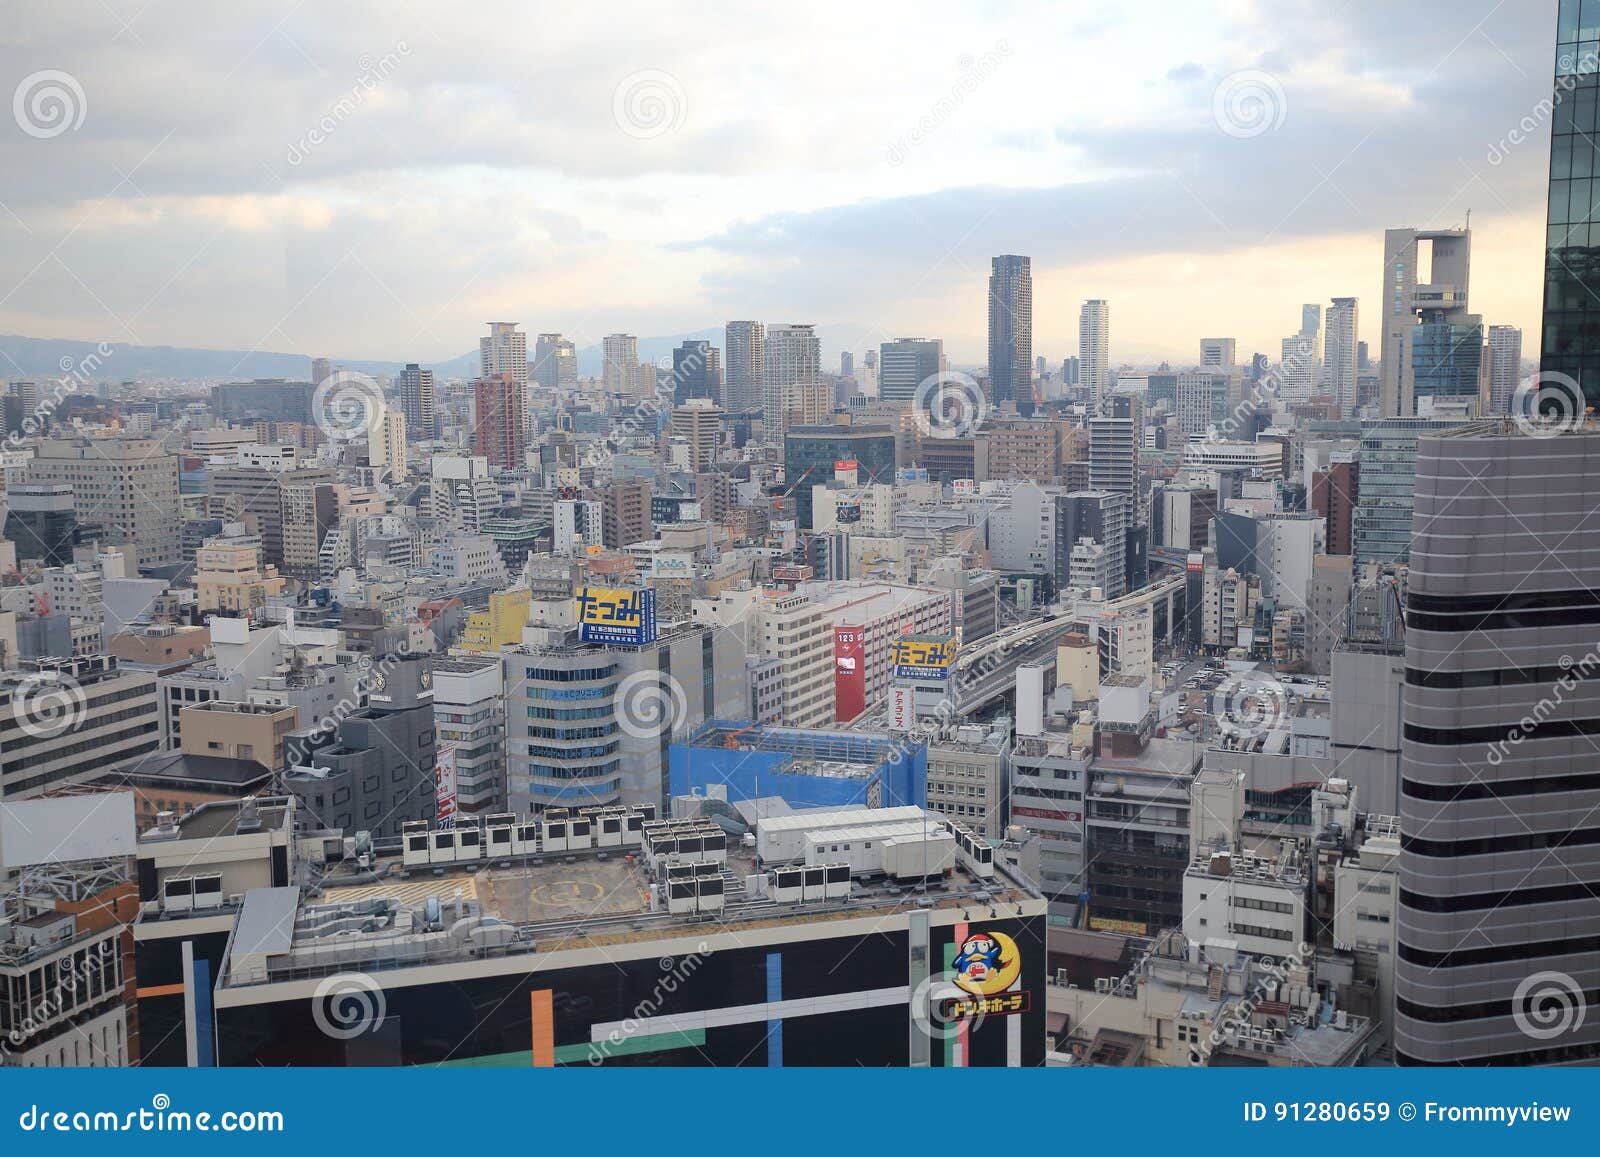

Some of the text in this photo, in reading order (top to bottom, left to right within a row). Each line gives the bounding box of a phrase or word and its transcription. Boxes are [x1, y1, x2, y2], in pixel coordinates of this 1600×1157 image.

[576, 587, 641, 622] たつみ
[838, 632, 854, 642] 123
[891, 640, 947, 666] たつみ
